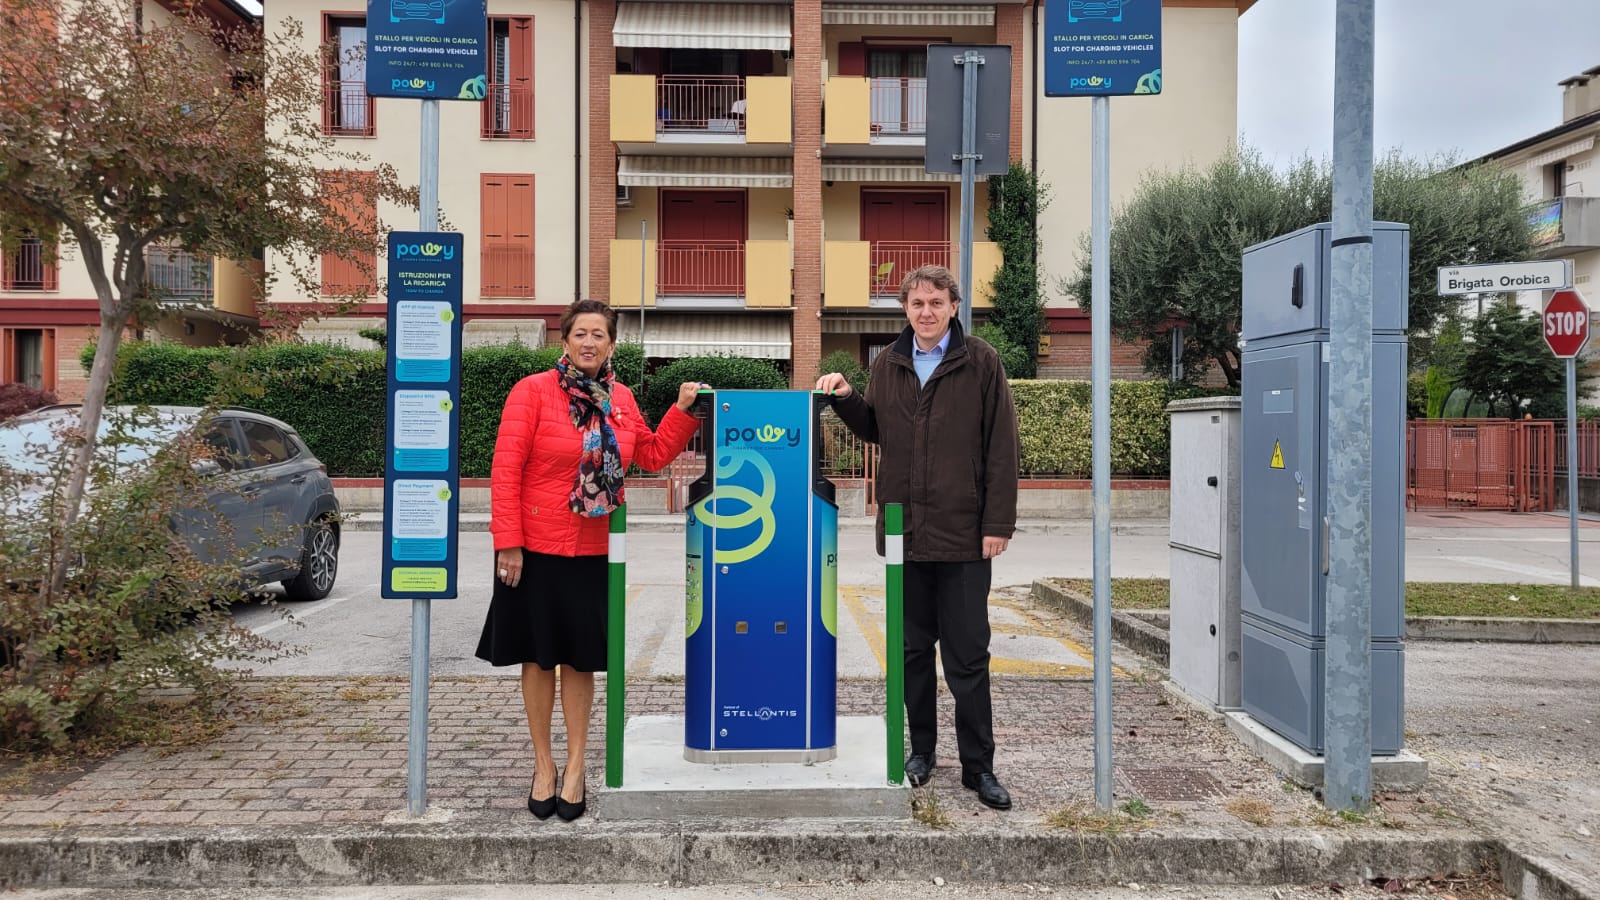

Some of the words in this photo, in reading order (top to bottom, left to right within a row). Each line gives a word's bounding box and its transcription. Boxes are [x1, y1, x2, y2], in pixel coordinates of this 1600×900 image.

[392, 78, 435, 91] powy
[1070, 76, 1111, 88] powy
[397, 242, 454, 259] powy
[1448, 278, 1493, 290] Brigata
[1500, 275, 1550, 286] Orobica
[1546, 311, 1585, 336] STOP
[725, 424, 800, 447] powy
[723, 710, 797, 718] STELLANTIS
